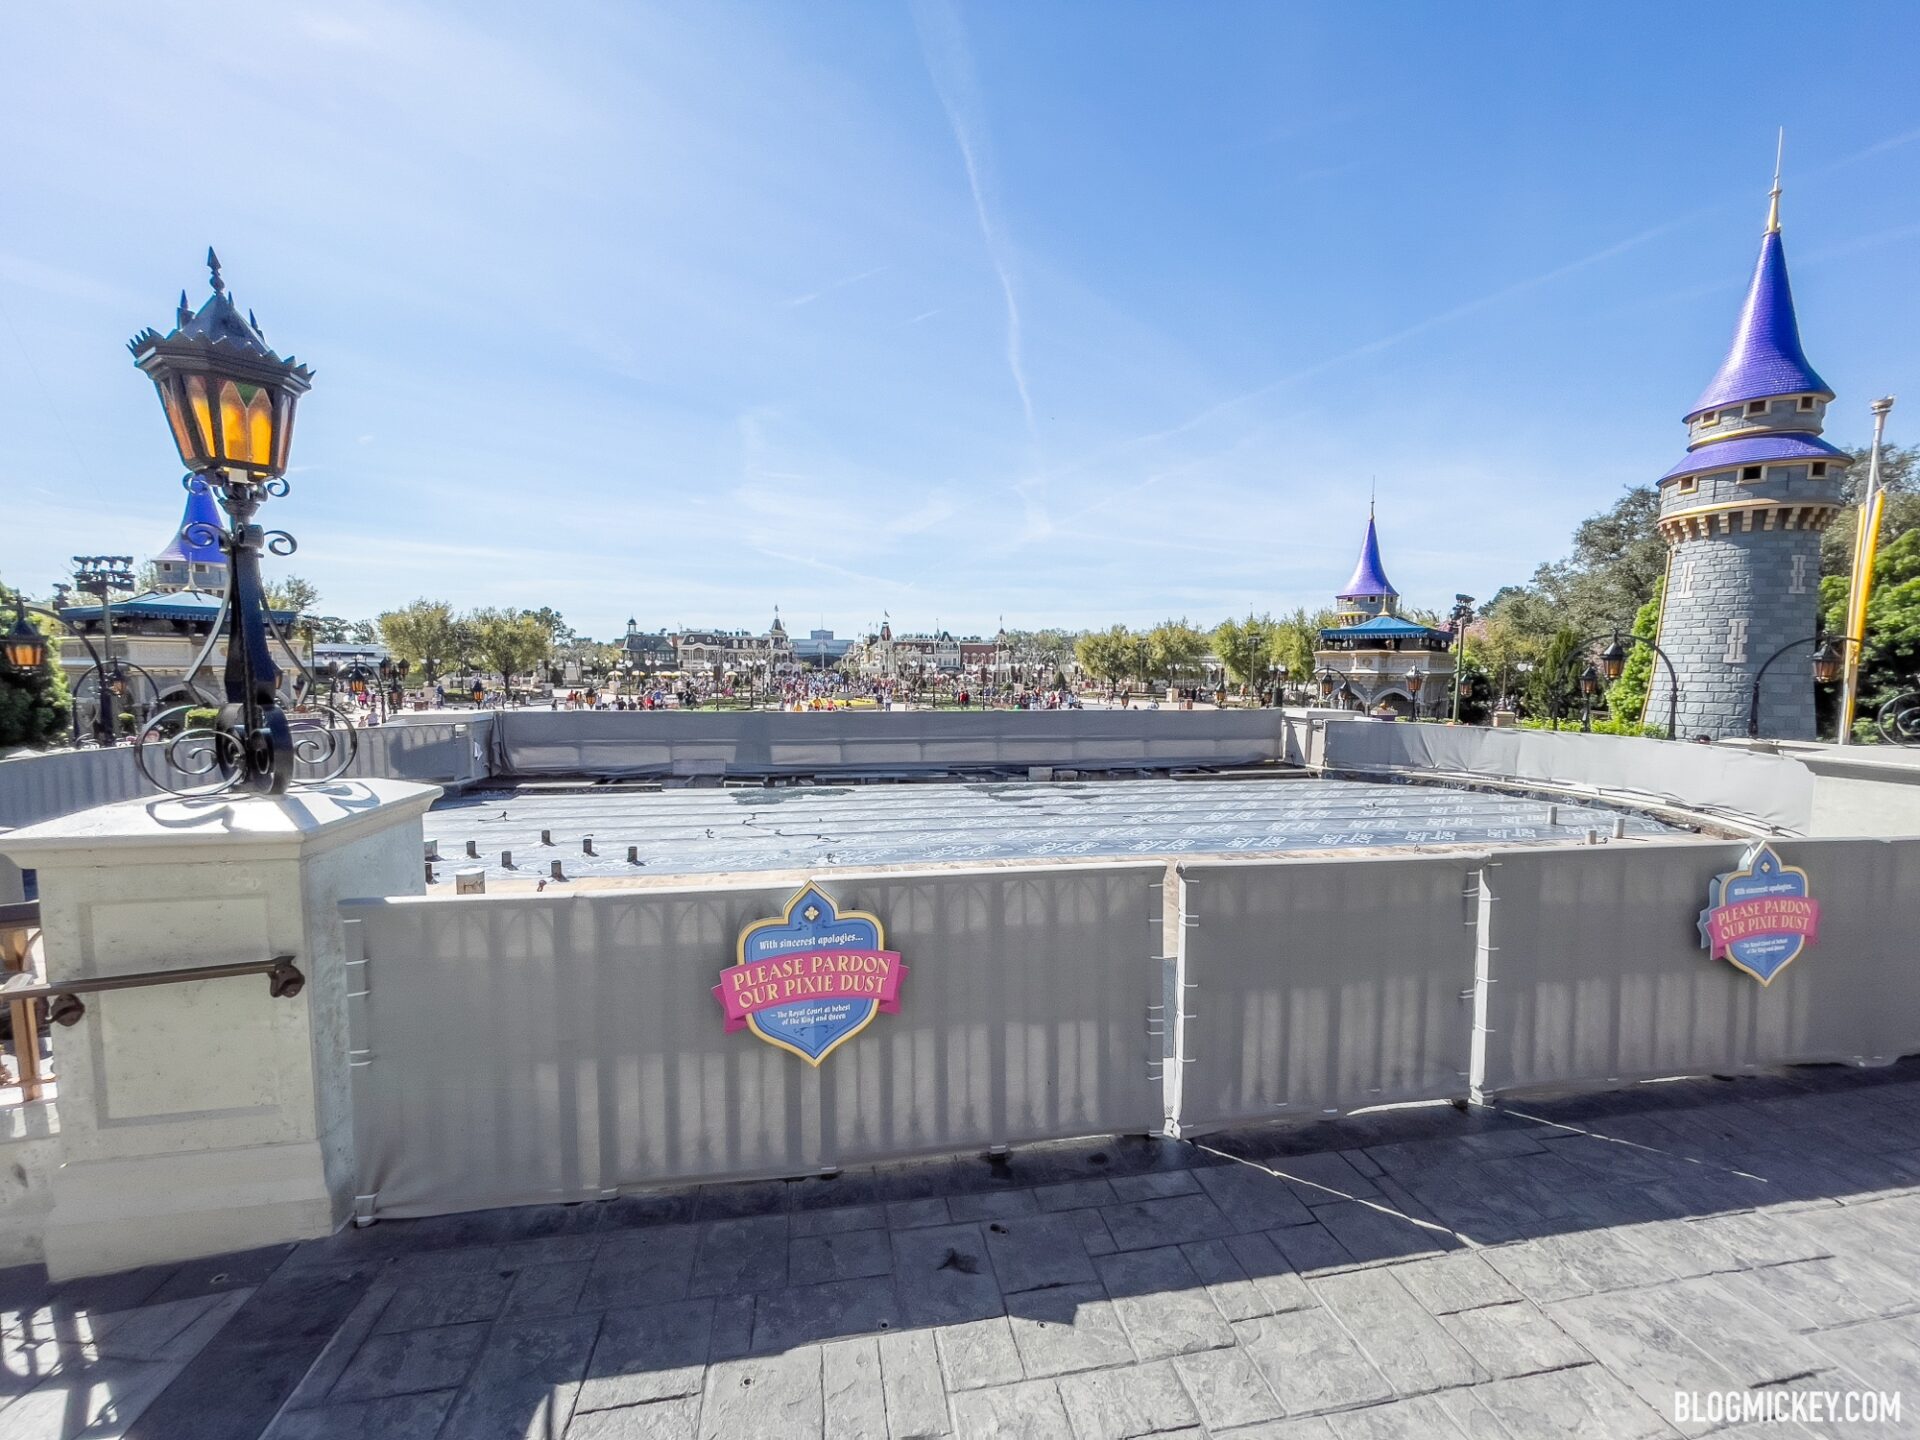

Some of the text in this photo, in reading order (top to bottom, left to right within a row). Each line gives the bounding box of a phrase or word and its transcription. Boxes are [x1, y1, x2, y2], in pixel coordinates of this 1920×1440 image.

[1718, 900, 1812, 927] PLEASE PARDON
[1721, 915, 1809, 940] OUR PIXIE DUST
[759, 933, 864, 950] With sincerest apologies...
[732, 955, 891, 992] PLEASE PARDON
[738, 974, 887, 1009] OUR PIXIE DUST
[788, 1009, 806, 1018] Royal
[806, 1007, 823, 1015] Court
